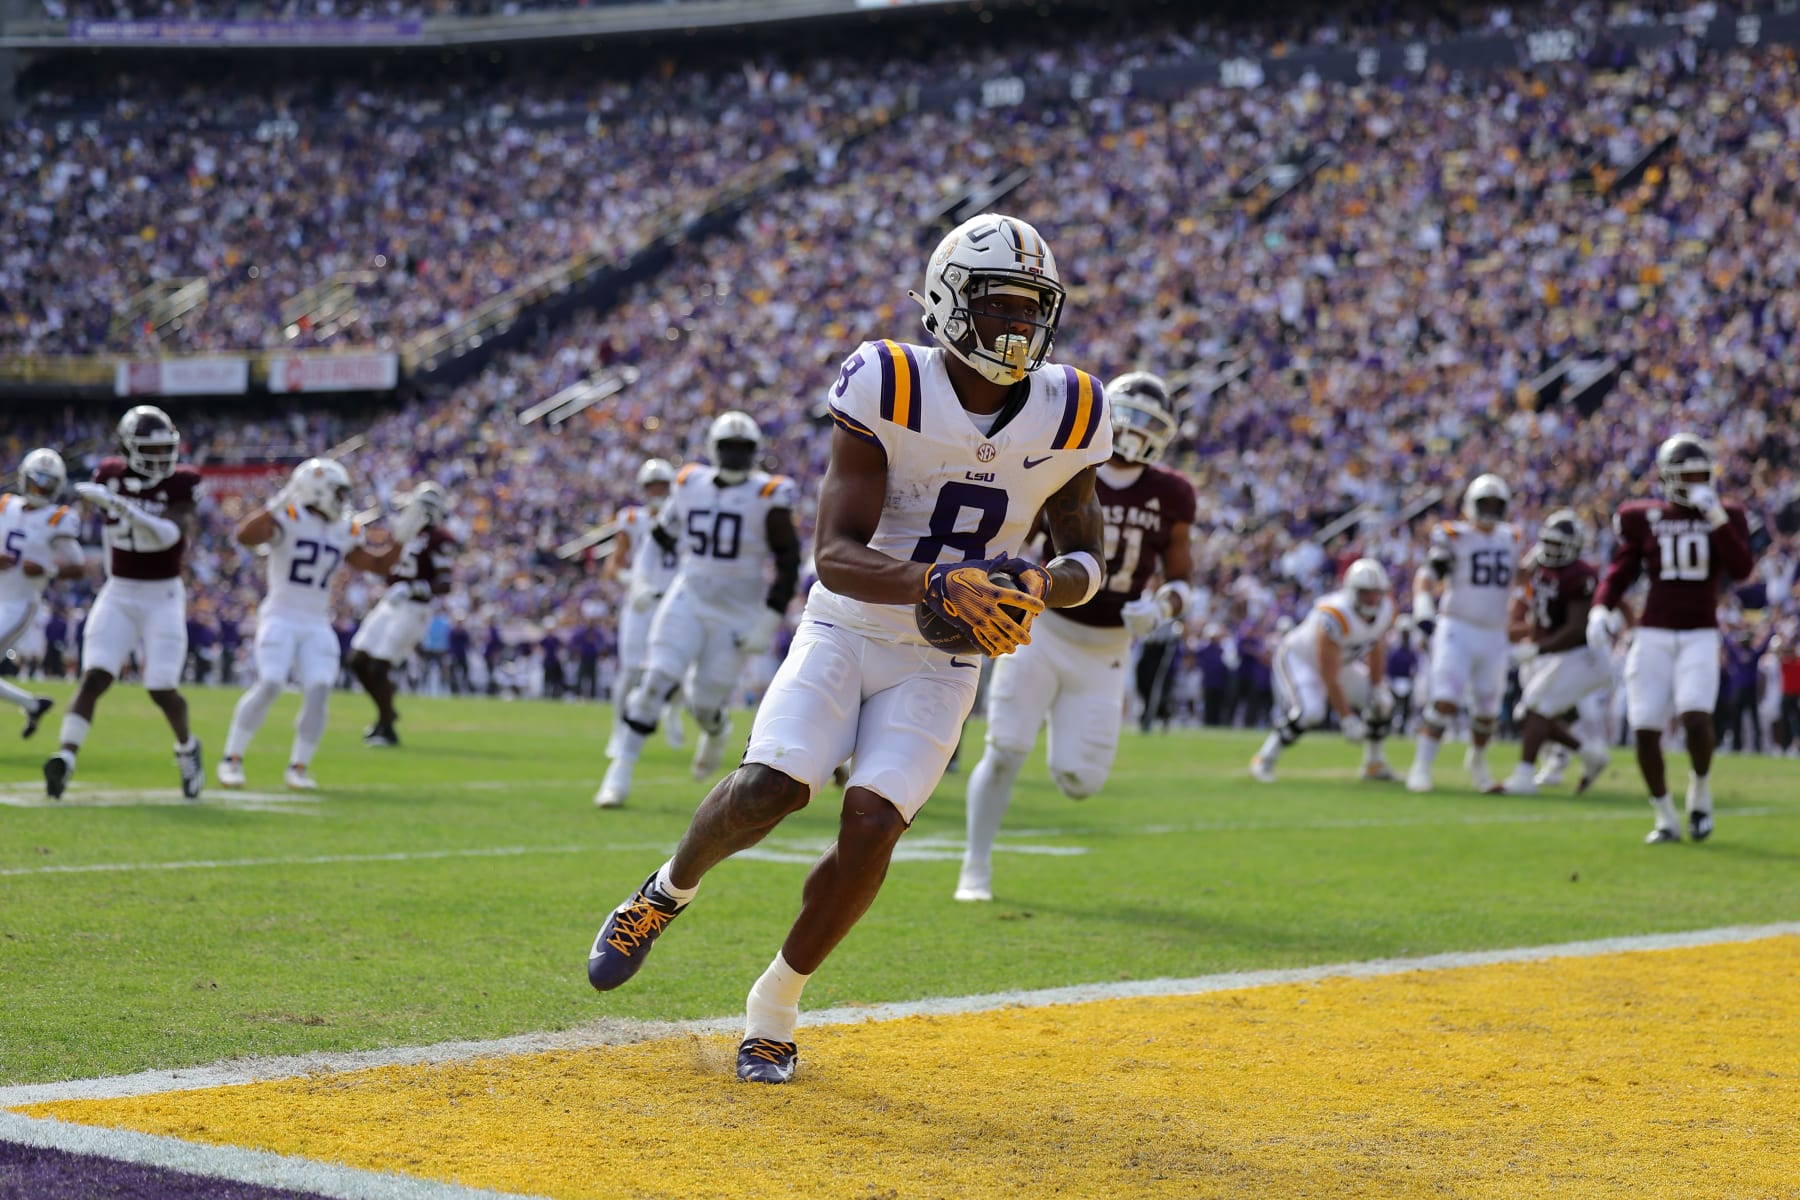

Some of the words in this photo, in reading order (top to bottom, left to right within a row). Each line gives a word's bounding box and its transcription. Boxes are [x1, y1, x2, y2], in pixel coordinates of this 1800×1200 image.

[835, 353, 865, 398] 8
[977, 444, 996, 462] SEC
[965, 470, 995, 483] LSU
[687, 510, 742, 560] 50
[910, 481, 1009, 565] 8
[5, 530, 25, 565] 5
[289, 539, 342, 590] 27
[1471, 551, 1512, 587] 66
[1657, 533, 1710, 581] 10
